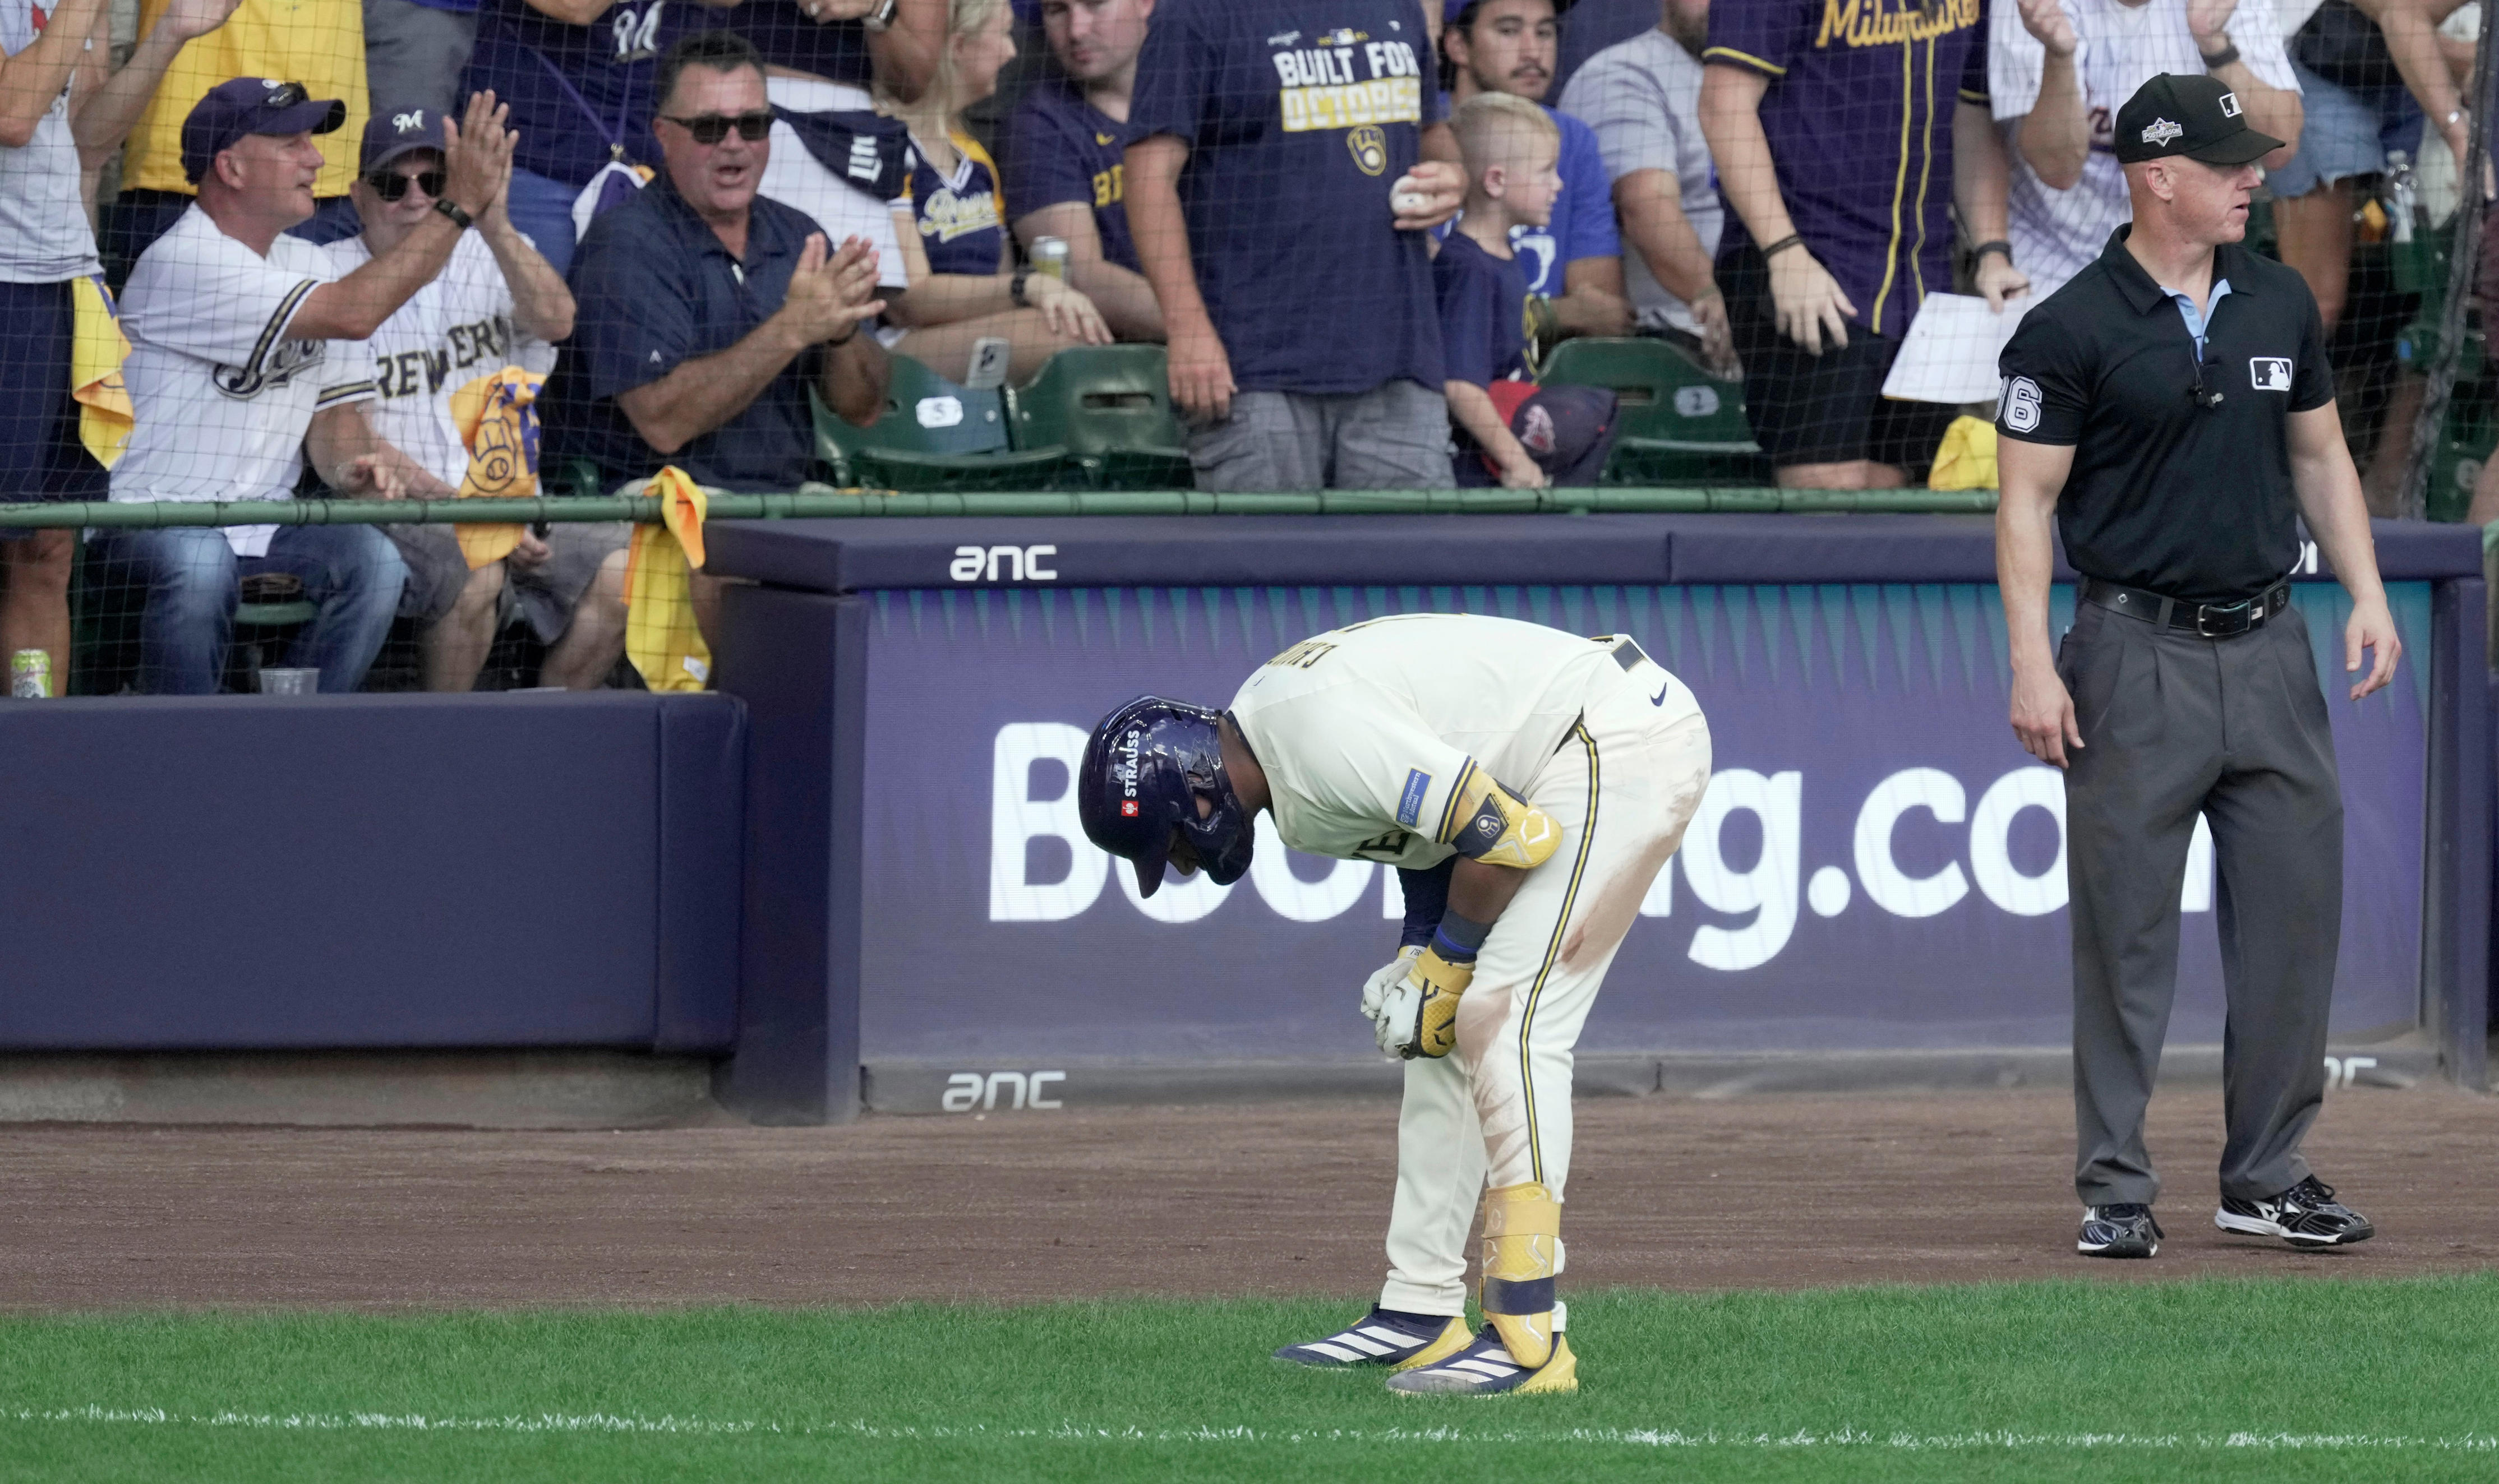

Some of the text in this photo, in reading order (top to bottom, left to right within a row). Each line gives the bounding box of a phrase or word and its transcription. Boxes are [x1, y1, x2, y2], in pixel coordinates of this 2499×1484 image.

[1272, 41, 1421, 87] BUILT FOR
[2144, 126, 2181, 139] POSTSEASON
[376, 313, 510, 399] REWER
[1994, 375, 2042, 433] 6
[949, 544, 1058, 582] anc
[1124, 729, 1140, 798] STRAUSS
[1403, 772, 1422, 814] Northwestern
[1408, 794, 1420, 816] Mutual
[989, 722, 2212, 971] Bog.co
[942, 1070, 1067, 1112] anc
